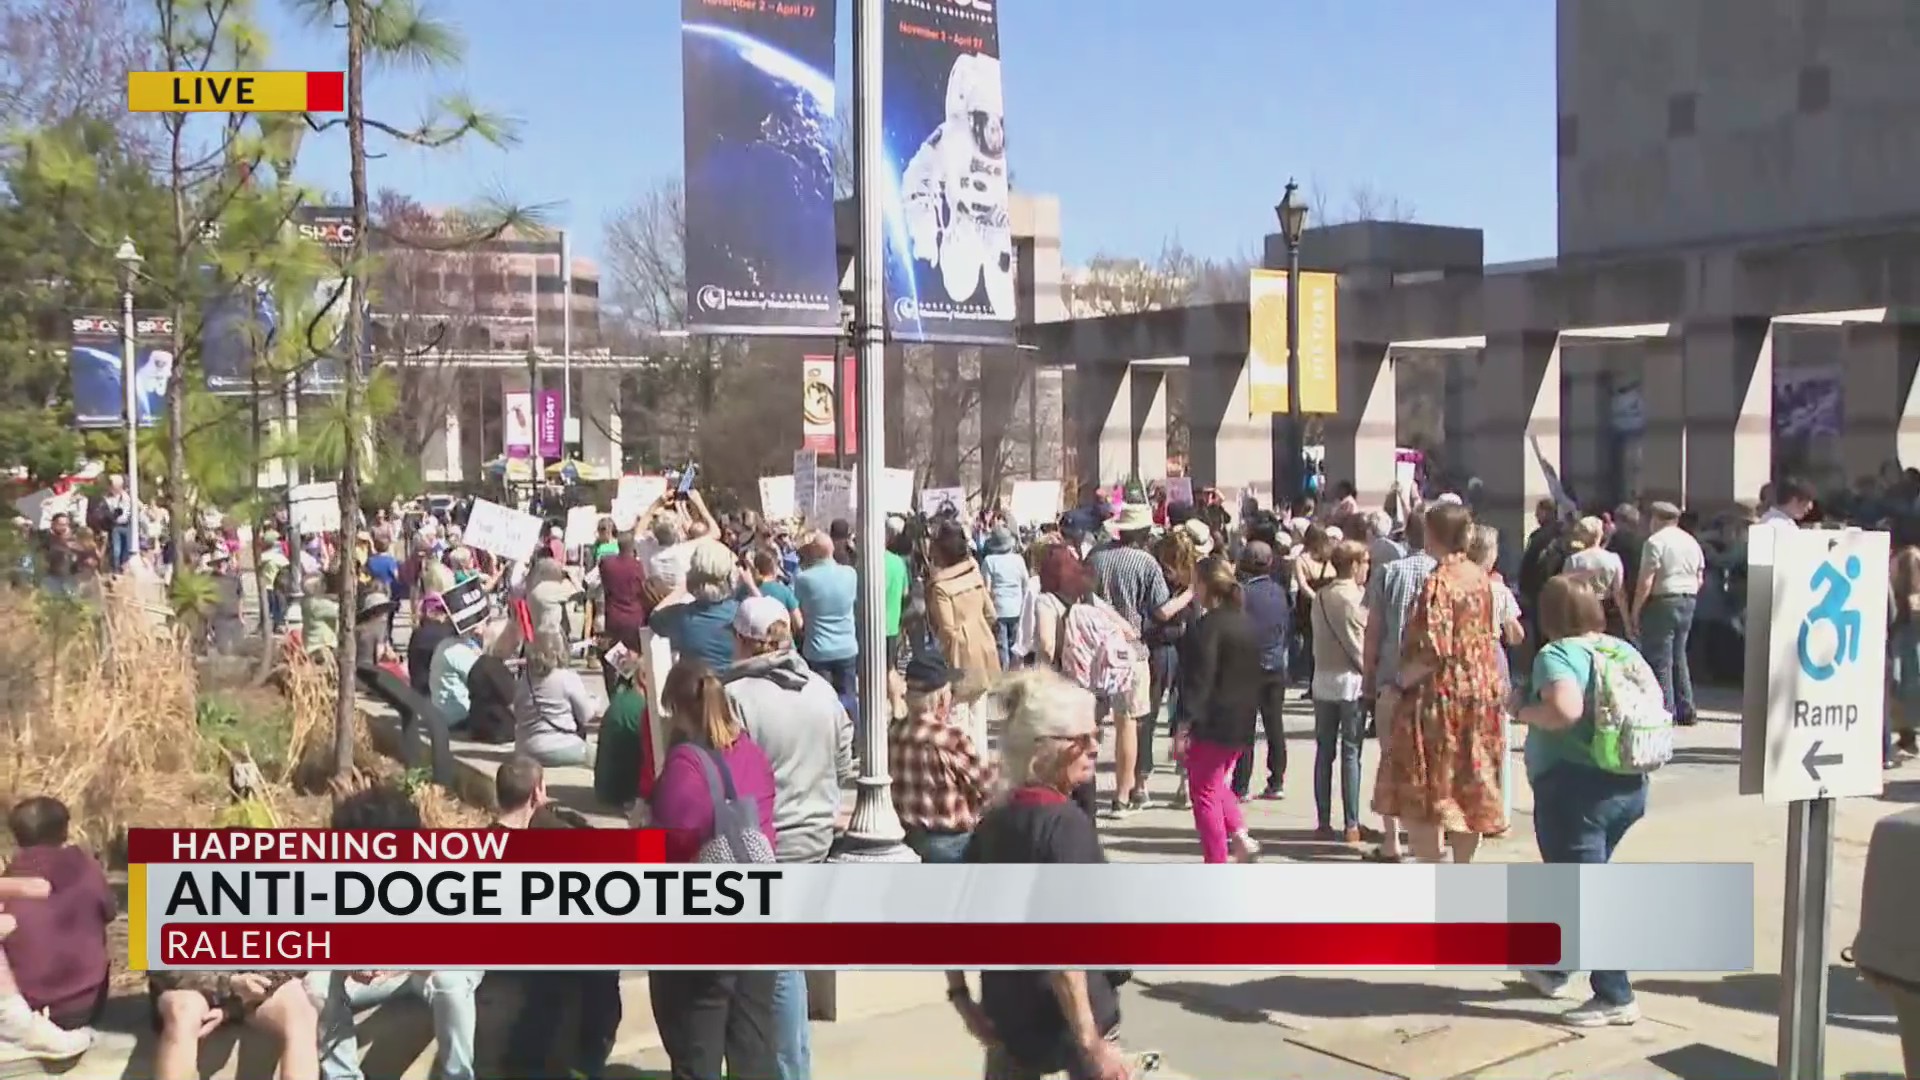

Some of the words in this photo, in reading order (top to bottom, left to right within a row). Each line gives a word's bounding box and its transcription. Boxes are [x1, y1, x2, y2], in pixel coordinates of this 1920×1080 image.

[776, 2, 800, 16] April
[300, 223, 355, 242] SPAC
[137, 320, 174, 333] SPAC
[546, 396, 555, 443] HISTORY
[1794, 700, 1858, 732] Ramp
